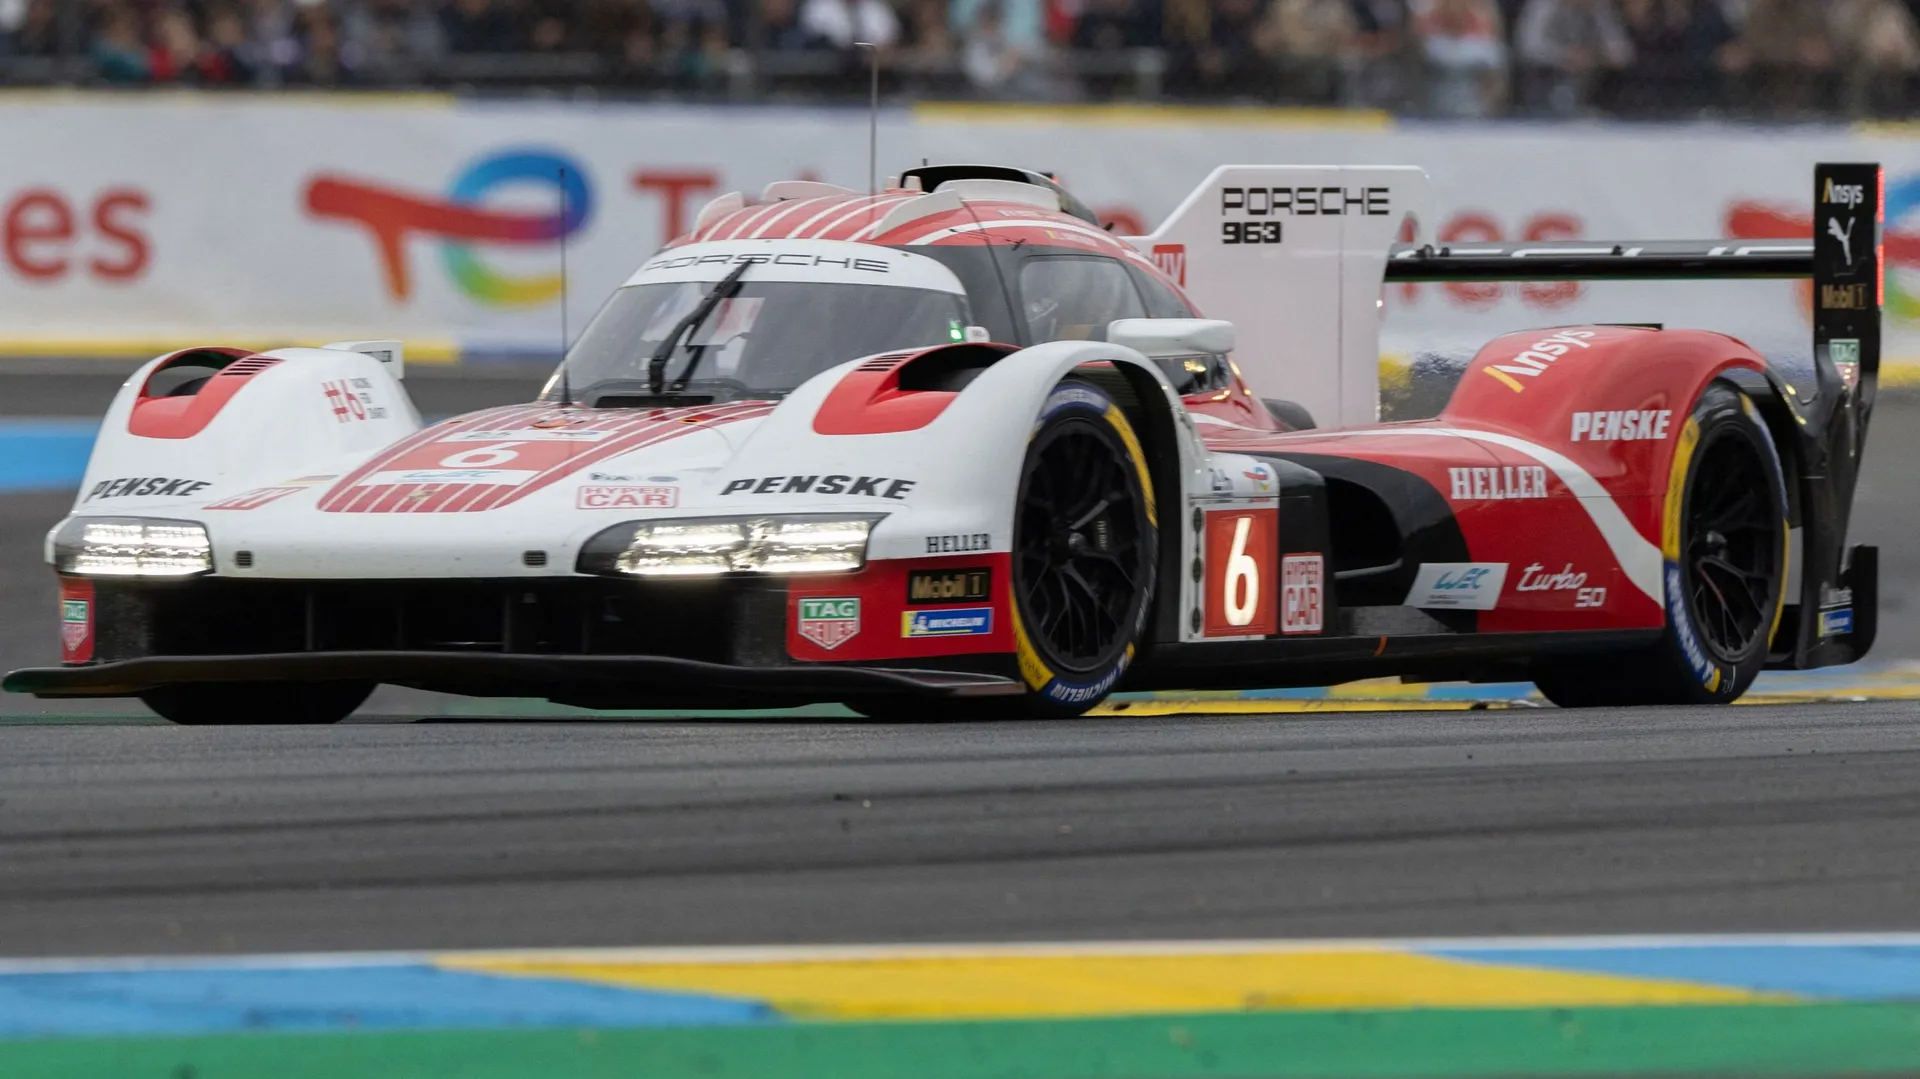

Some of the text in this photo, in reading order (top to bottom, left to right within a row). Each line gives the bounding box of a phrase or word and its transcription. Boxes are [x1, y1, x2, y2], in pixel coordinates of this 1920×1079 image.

[1222, 187, 1390, 216] PORSCHE
[1822, 177, 1864, 209] Ansys
[1222, 221, 1282, 245] 963
[646, 253, 890, 274] PORSCHE
[1482, 328, 1597, 394] Ansys
[321, 379, 366, 424] #6
[1570, 409, 1673, 442] PENSKE
[438, 441, 532, 468] 6
[83, 477, 213, 504] PENSKE
[719, 474, 916, 500] PENSKE
[1448, 466, 1549, 500] HELLER
[586, 494, 669, 506] CAR
[926, 533, 992, 553] HELLER
[1224, 517, 1259, 626] 6
[1516, 562, 1588, 592] turbo
[912, 574, 966, 599] Mobil
[1574, 587, 1607, 608] 50
[803, 601, 857, 618] TAG
[1285, 587, 1320, 626] CAR
